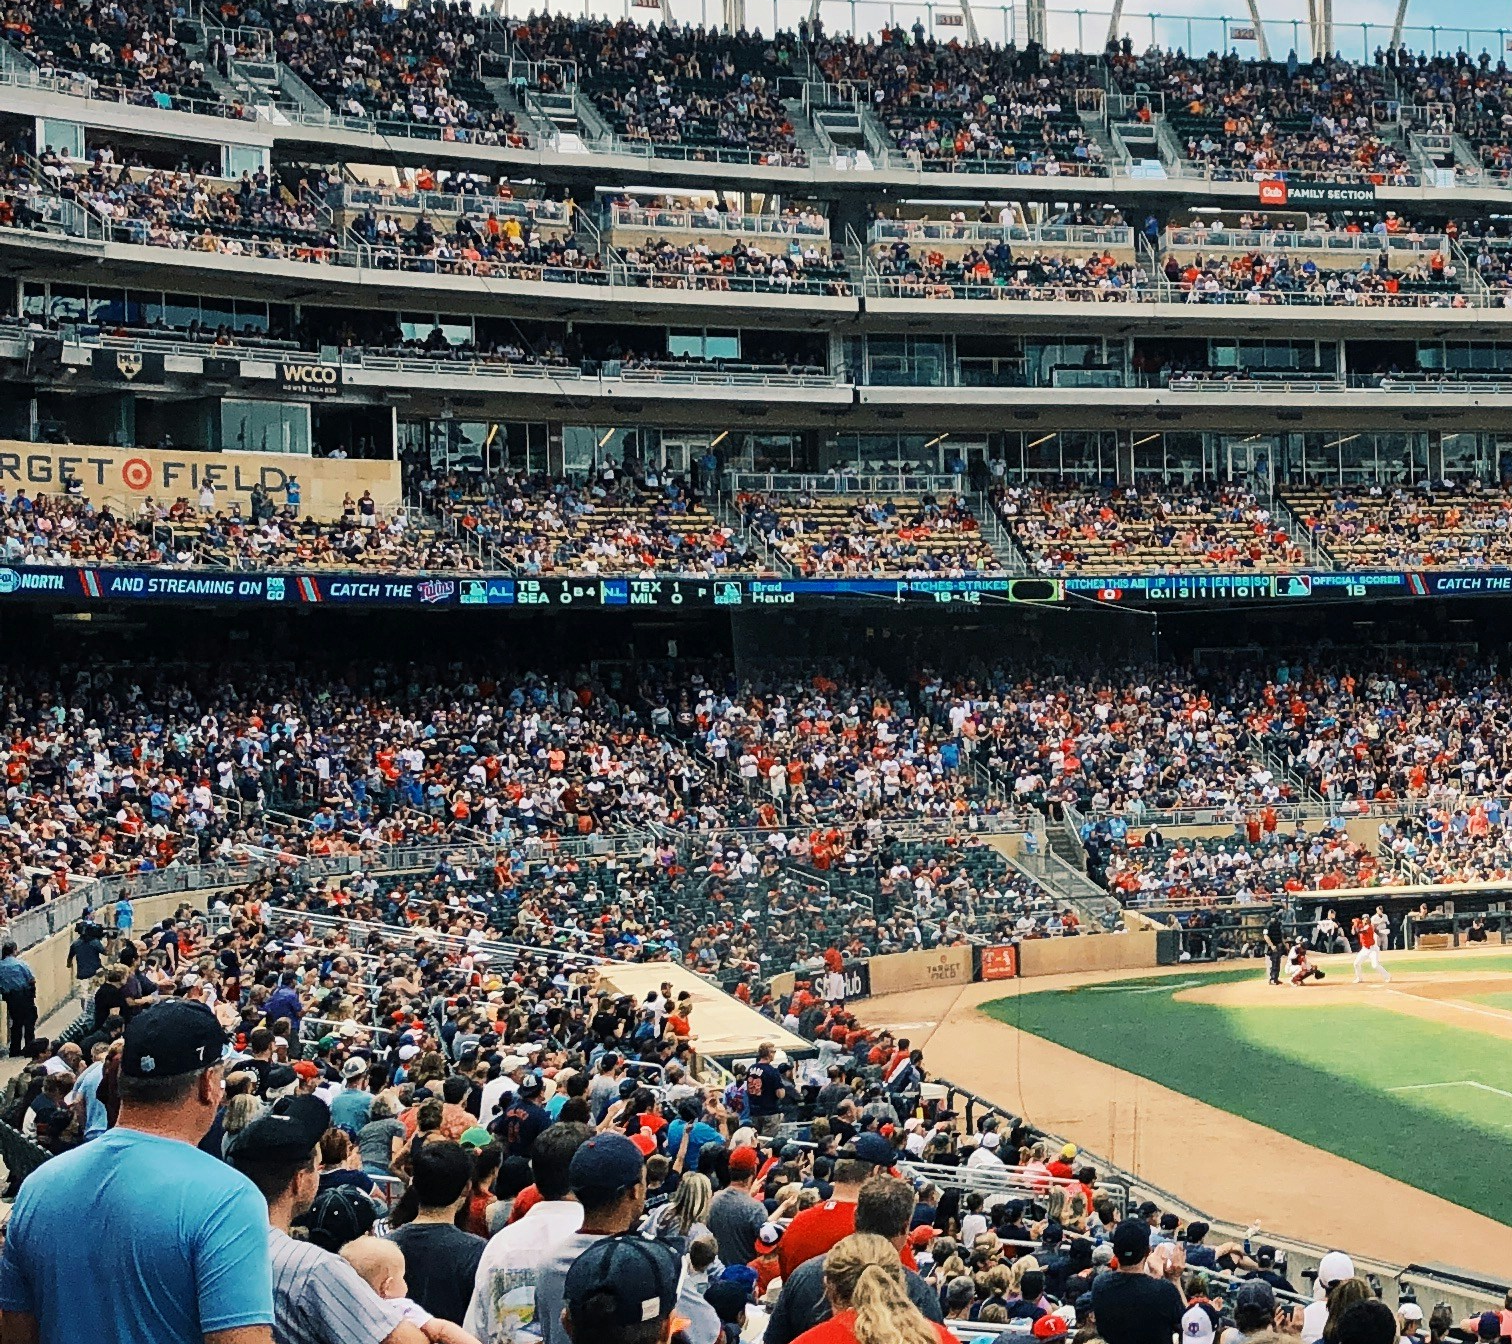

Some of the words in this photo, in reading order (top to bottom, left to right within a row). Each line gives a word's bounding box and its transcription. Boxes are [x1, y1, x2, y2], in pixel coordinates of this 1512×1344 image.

[1287, 188, 1325, 199] FAMILY
[1327, 189, 1374, 200] SECTION
[282, 364, 337, 384] WCCO
[162, 461, 288, 493] FIELD
[111, 577, 144, 592] AND
[148, 578, 235, 595] STREAMING
[238, 581, 262, 595] ON
[517, 580, 541, 591] TB
[561, 580, 568, 592] 1
[631, 581, 662, 592] TEX
[673, 581, 680, 592] 1
[752, 581, 782, 592] Brad
[1065, 577, 1105, 590] PITCHES
[1107, 577, 1129, 589] THIS
[1154, 577, 1166, 588] IP
[1215, 577, 1231, 587] ER
[1437, 577, 1482, 590] CATCH
[1485, 576, 1511, 589] THE
[330, 582, 380, 598] CATCH
[385, 583, 413, 598] THE
[416, 578, 455, 604] Twins
[586, 586, 596, 597] 4
[1150, 588, 1170, 599] 0.1
[1346, 585, 1366, 597] 1B
[517, 593, 550, 604] SEA
[631, 593, 658, 604] MIL
[752, 592, 795, 604] Hand
